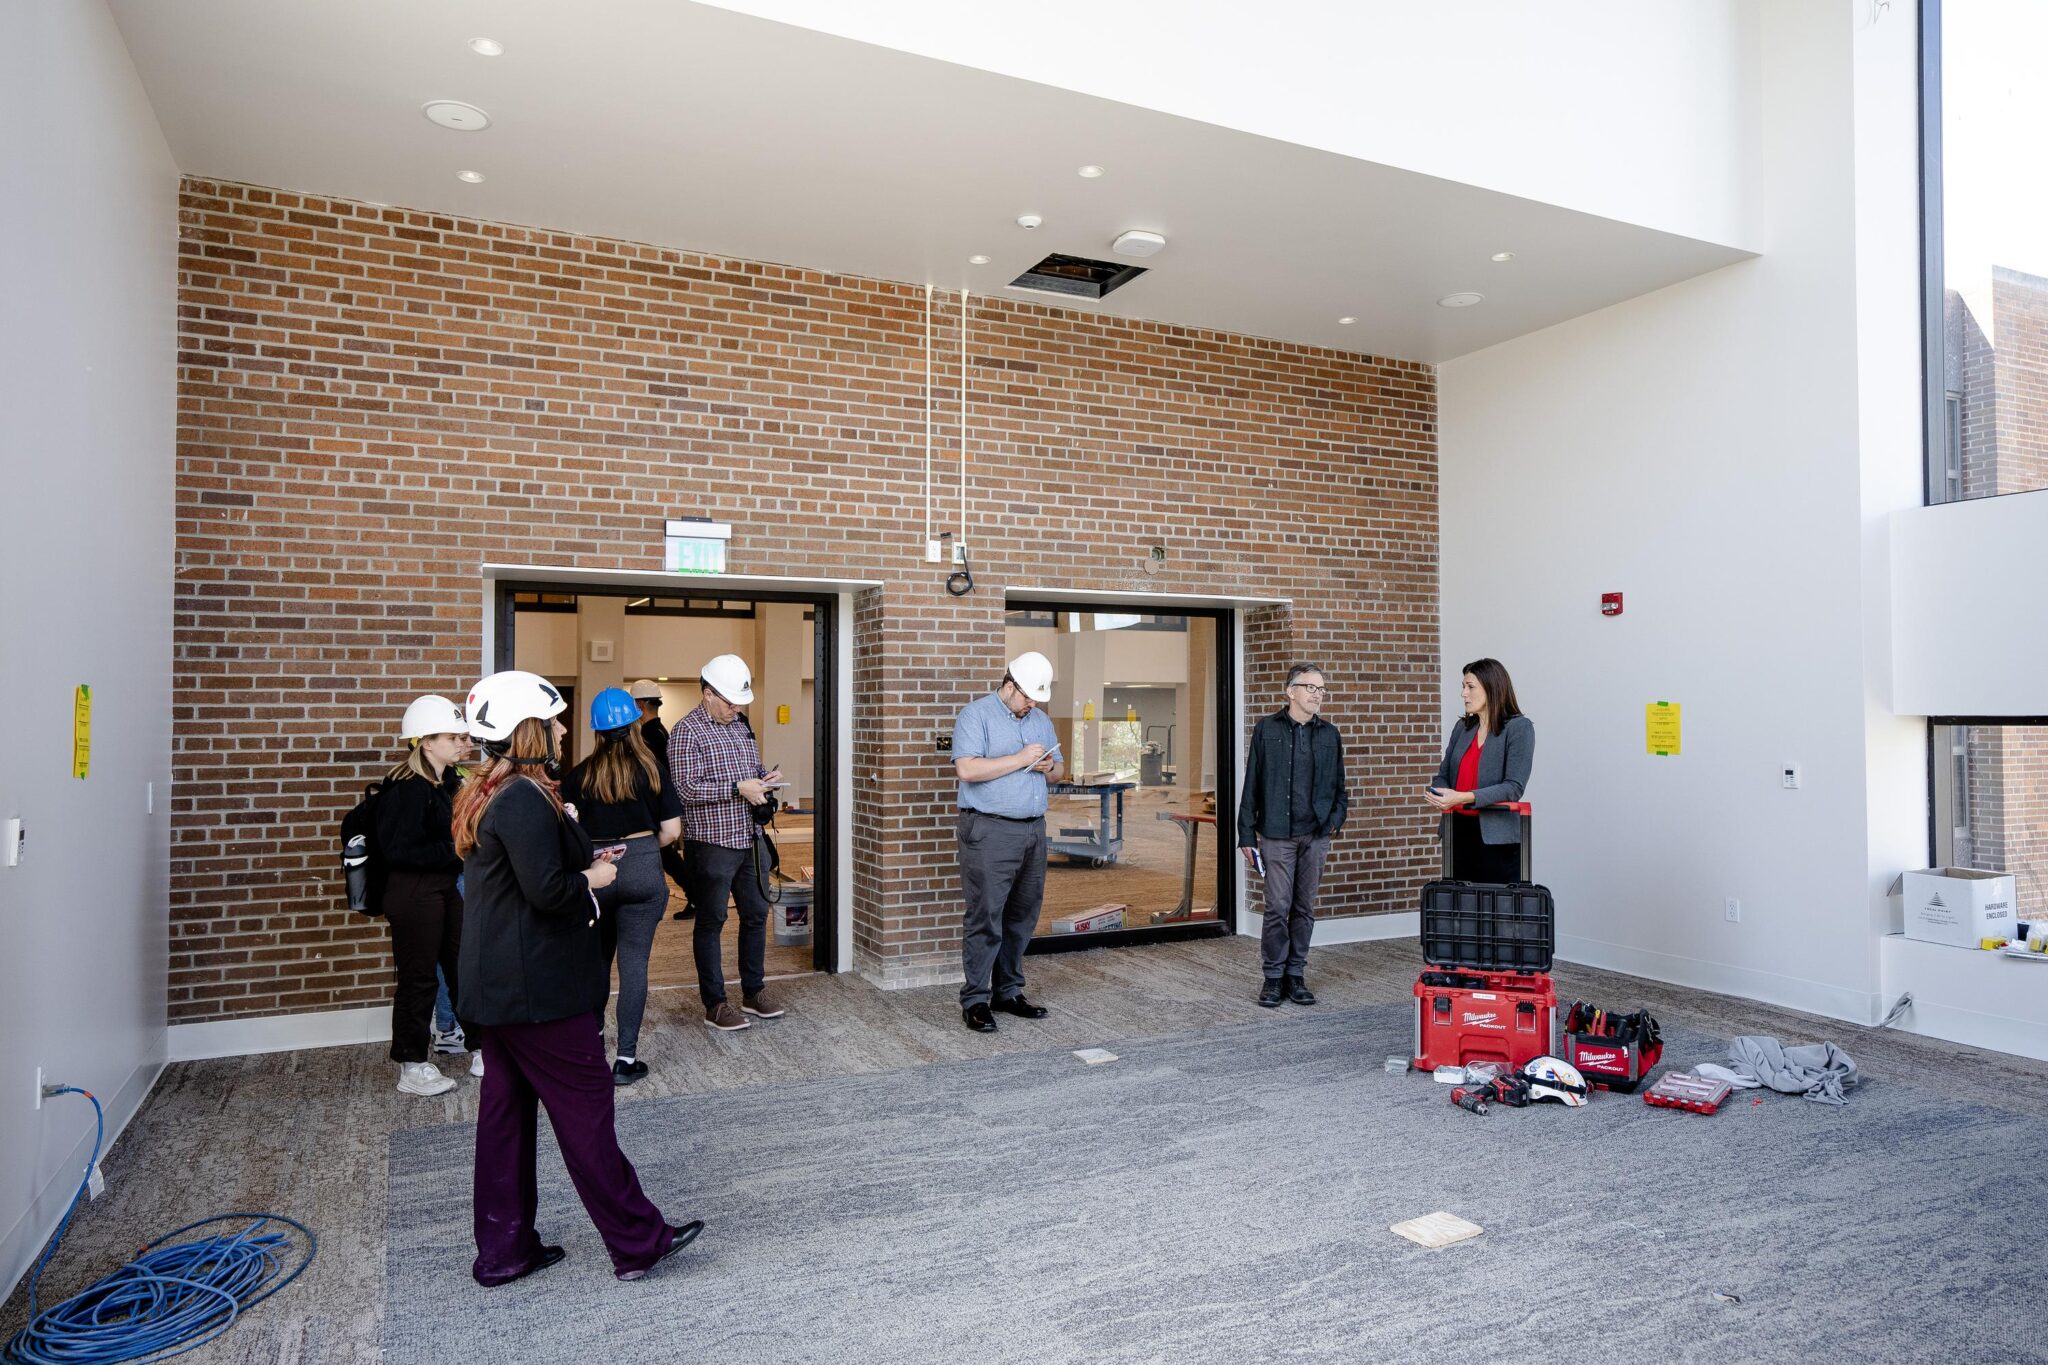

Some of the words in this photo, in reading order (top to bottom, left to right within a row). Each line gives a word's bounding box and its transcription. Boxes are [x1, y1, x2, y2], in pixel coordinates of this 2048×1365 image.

[678, 542, 721, 574] EXIT
[1985, 902, 2008, 911] HARDWARE
[1986, 911, 2008, 920] ENCLOSED
[1462, 1012, 1496, 1022] Milwaukee
[1578, 1051, 1616, 1062] Milwaukee
